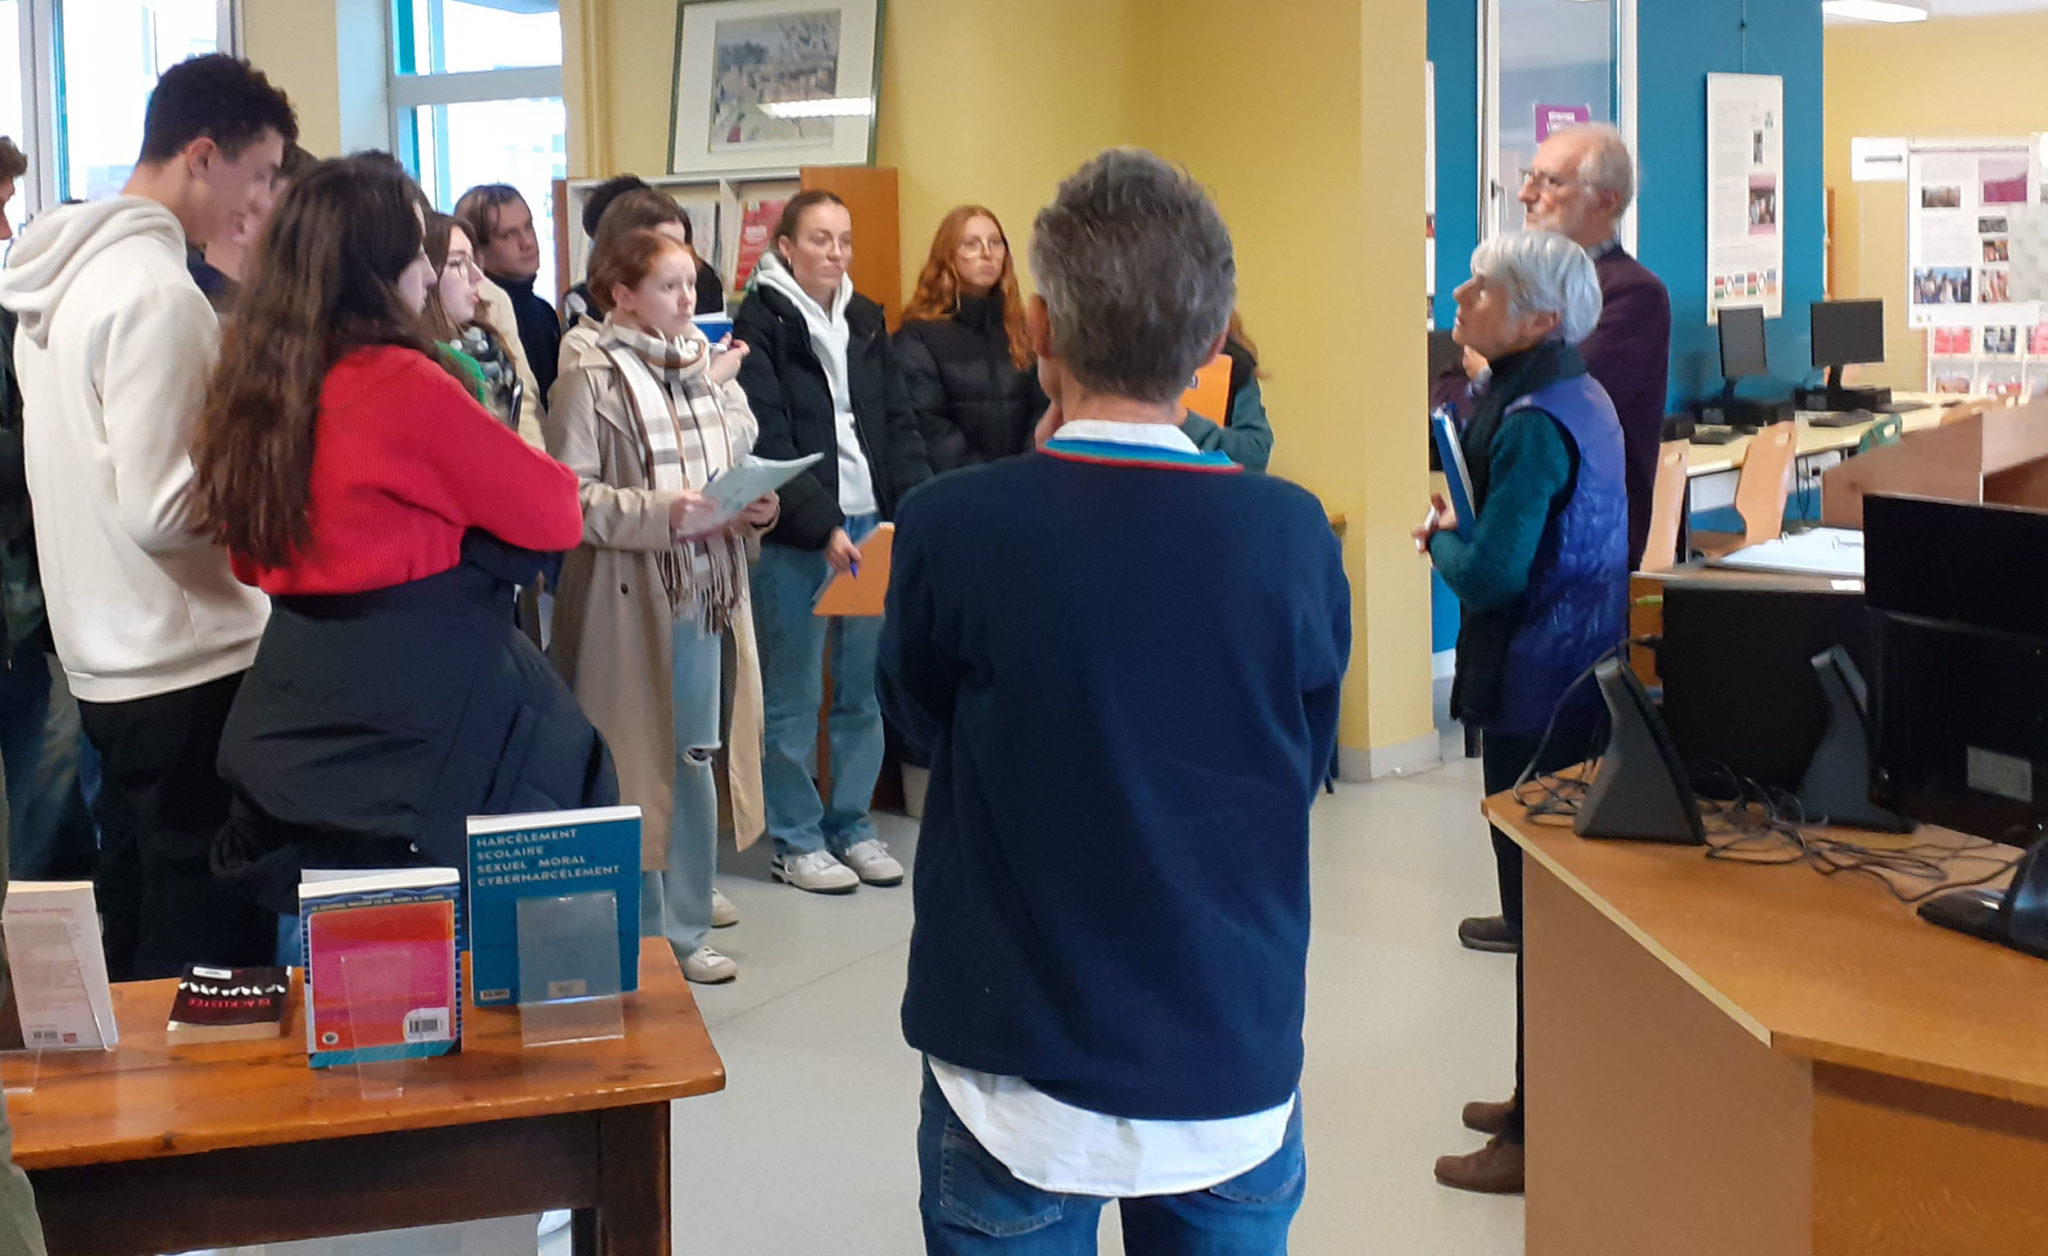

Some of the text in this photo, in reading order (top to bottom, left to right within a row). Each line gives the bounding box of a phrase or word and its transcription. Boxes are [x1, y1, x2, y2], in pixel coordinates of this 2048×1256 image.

[477, 846, 544, 860] SCOLAIRE
[477, 855, 586, 874] SEXUEL MORAL
